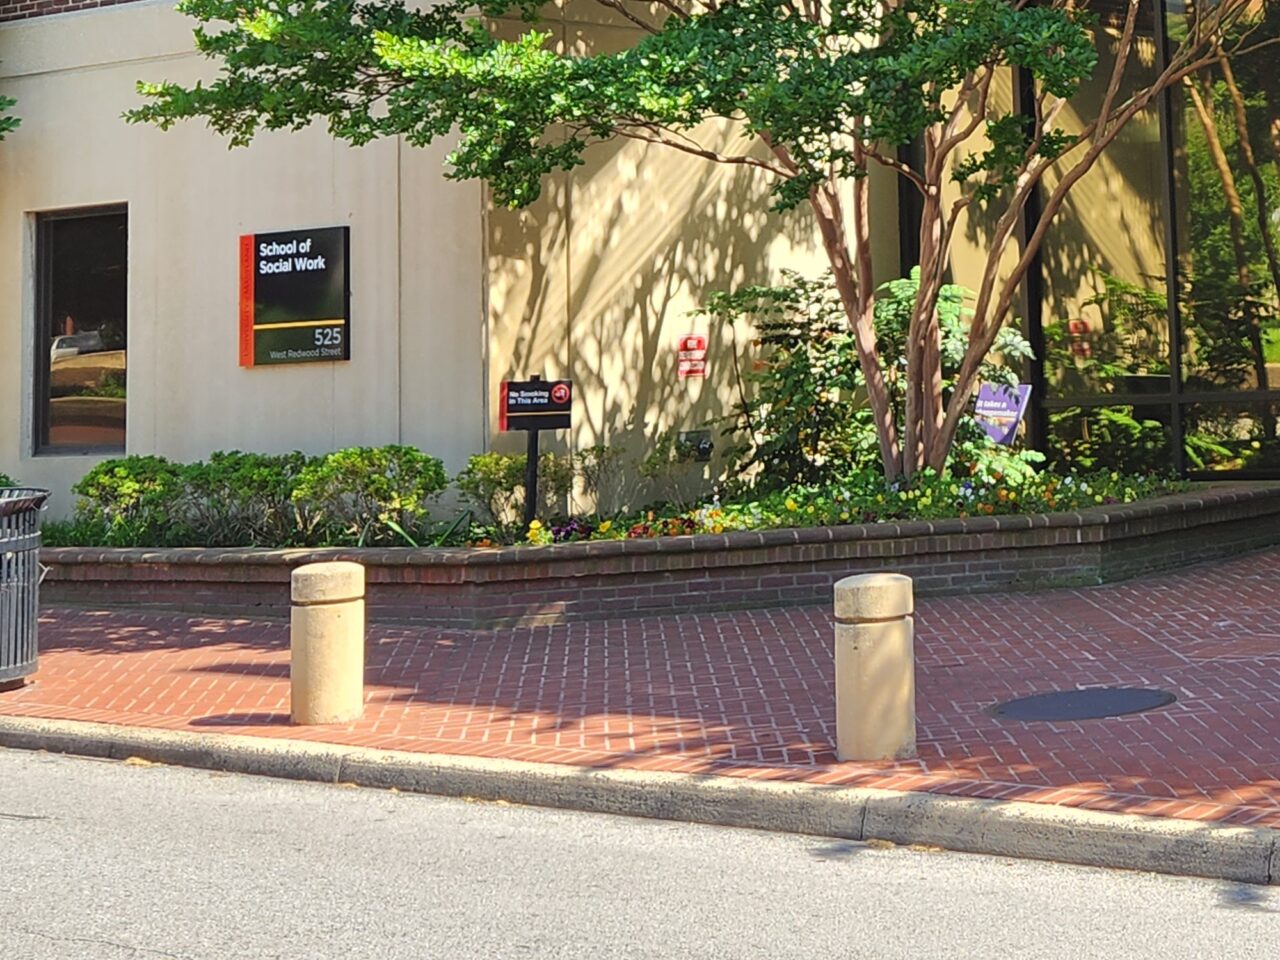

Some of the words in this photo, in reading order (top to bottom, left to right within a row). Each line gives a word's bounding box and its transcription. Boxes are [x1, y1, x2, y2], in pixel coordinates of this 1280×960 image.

[259, 240, 297, 256] School
[299, 238, 312, 253] of
[259, 258, 292, 274] Social
[294, 256, 326, 271] Work
[314, 328, 342, 346] 525
[270, 350, 287, 359] West
[288, 348, 320, 359] Redwood
[321, 346, 342, 357] Street
